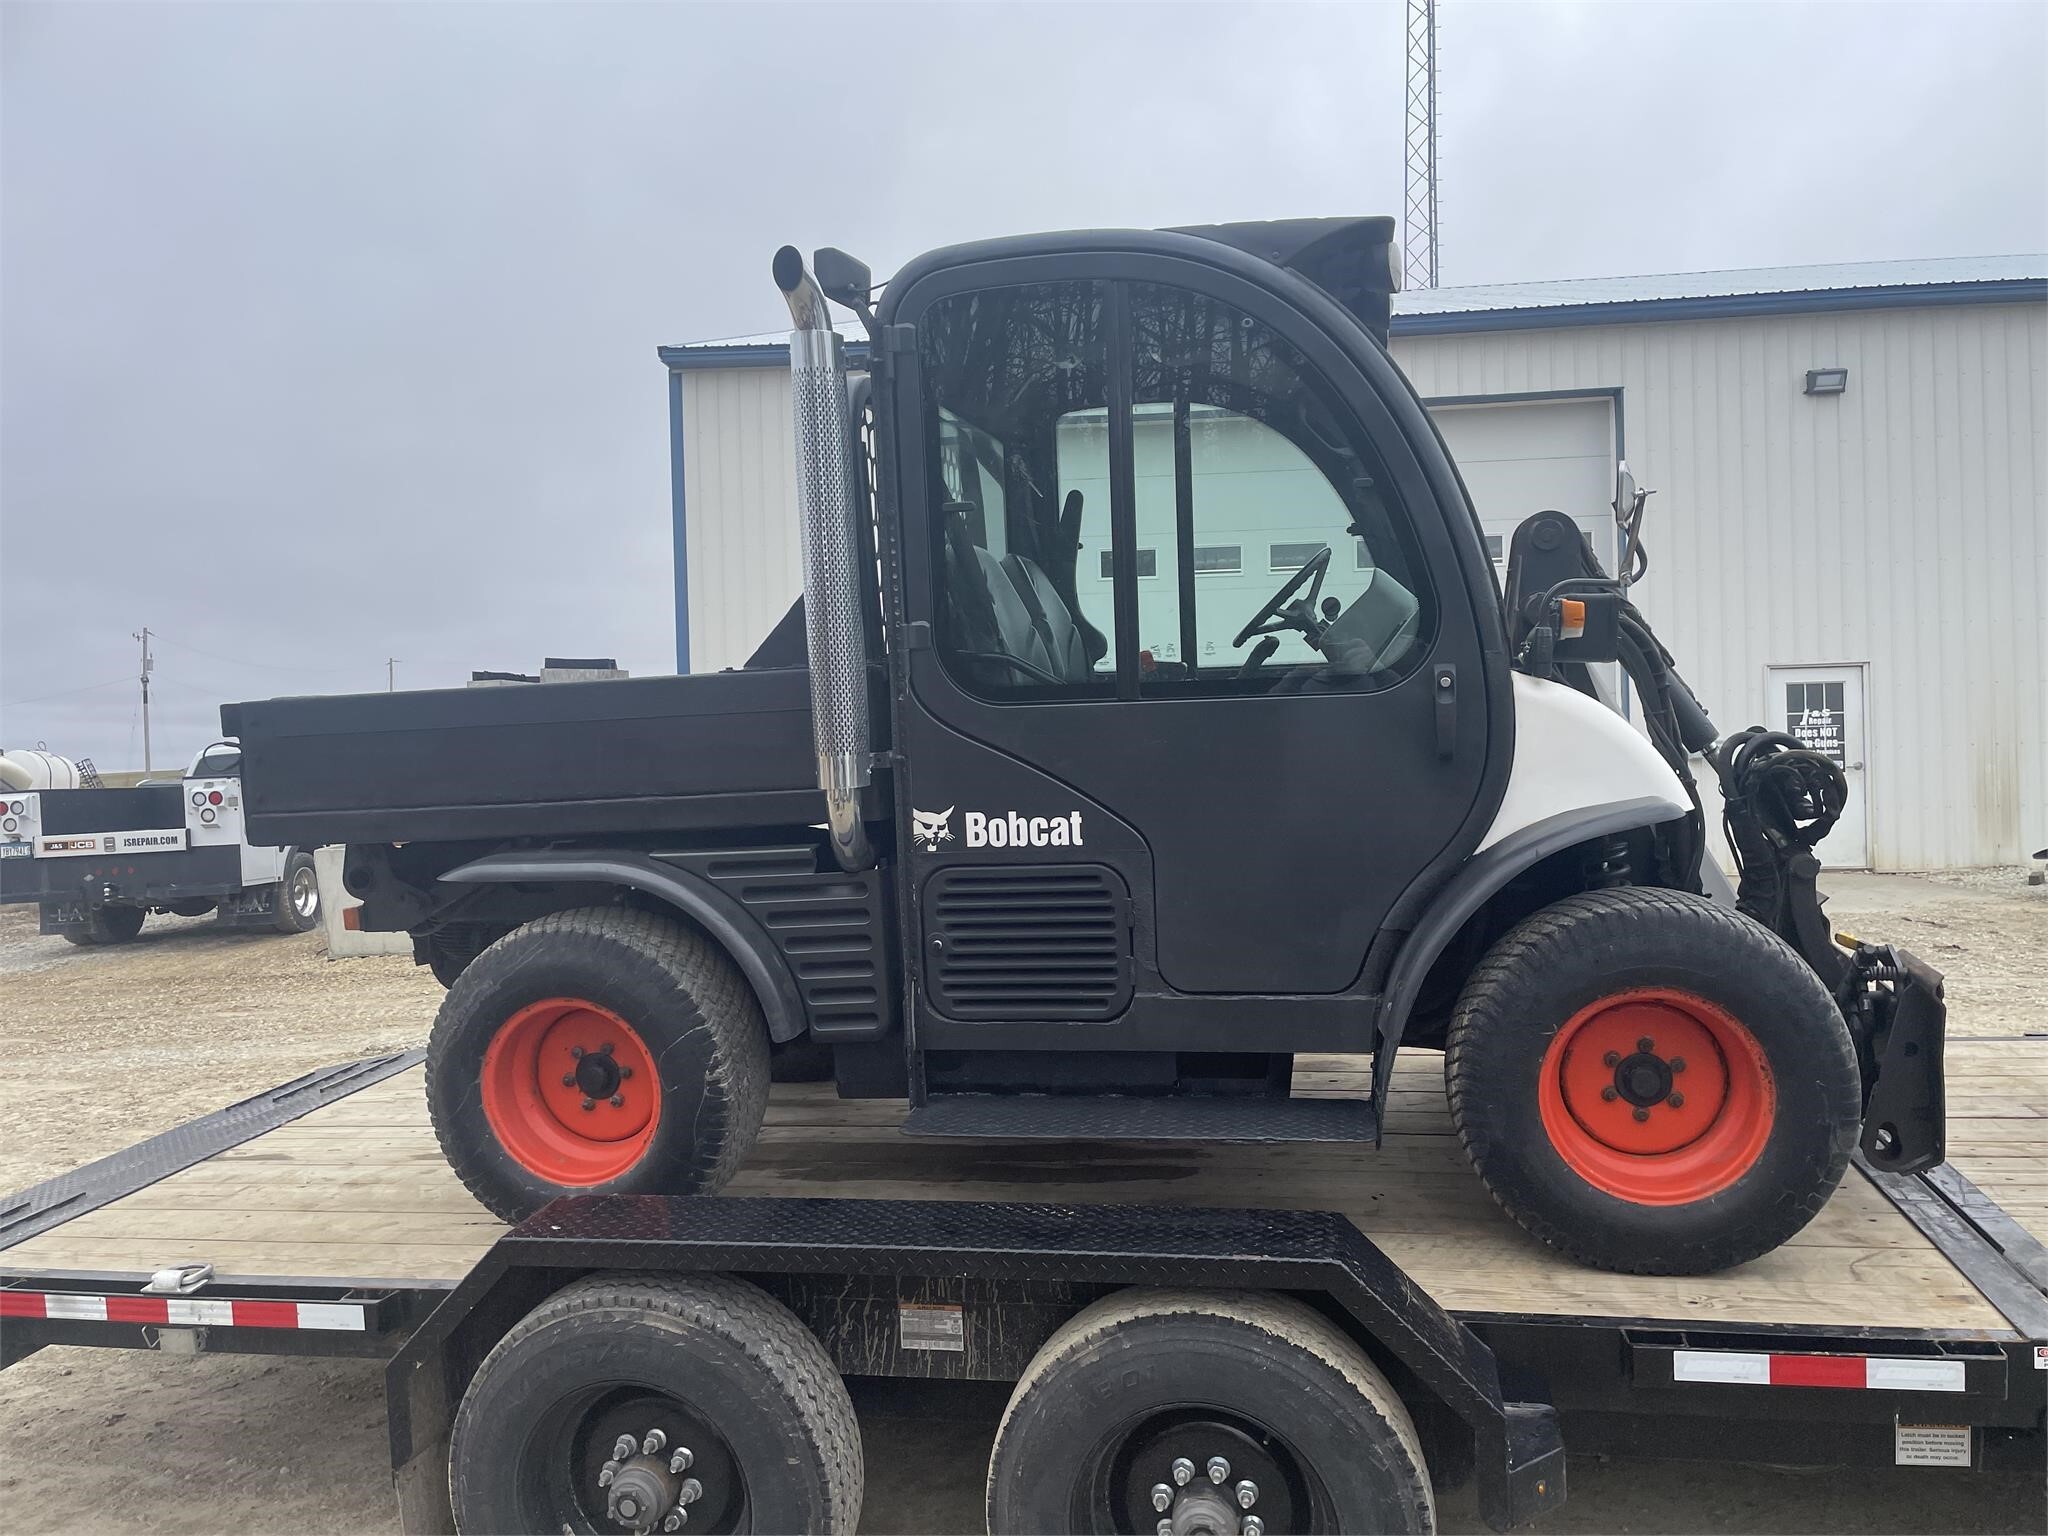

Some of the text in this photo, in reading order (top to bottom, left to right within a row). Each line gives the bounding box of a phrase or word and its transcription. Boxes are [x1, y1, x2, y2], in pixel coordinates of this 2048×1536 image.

[1809, 717, 1832, 725] Repair
[1795, 727, 1838, 738] Does NOT
[1814, 738, 1838, 748] Guns
[965, 811, 1084, 848] Bobcat
[70, 841, 94, 849] JCB
[123, 836, 178, 847] JSREPAIR.COM
